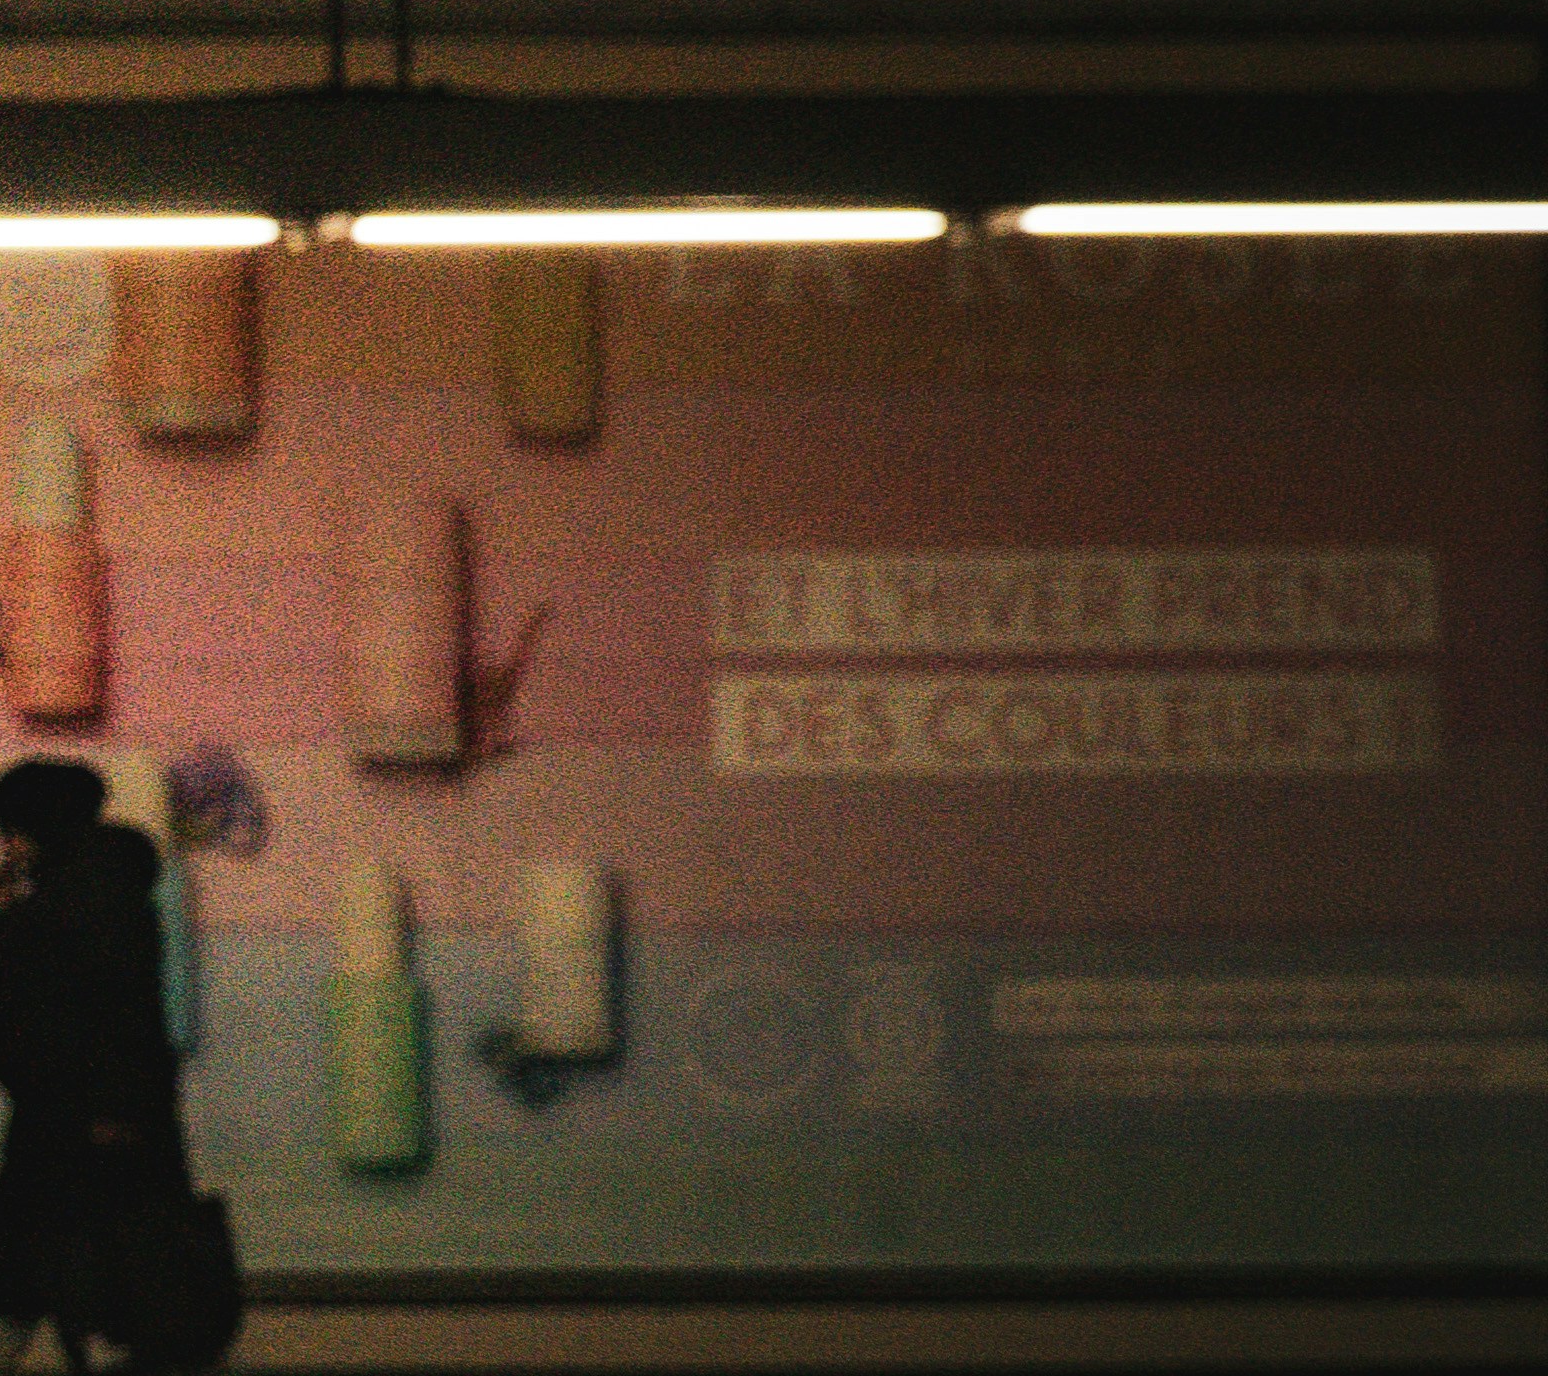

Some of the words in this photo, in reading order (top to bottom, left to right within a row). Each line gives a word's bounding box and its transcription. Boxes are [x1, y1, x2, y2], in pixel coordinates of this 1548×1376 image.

[727, 567, 810, 635] ET
[1155, 567, 1420, 634] PREND
[740, 691, 896, 761] DES
[924, 691, 1366, 760] COULEURS
